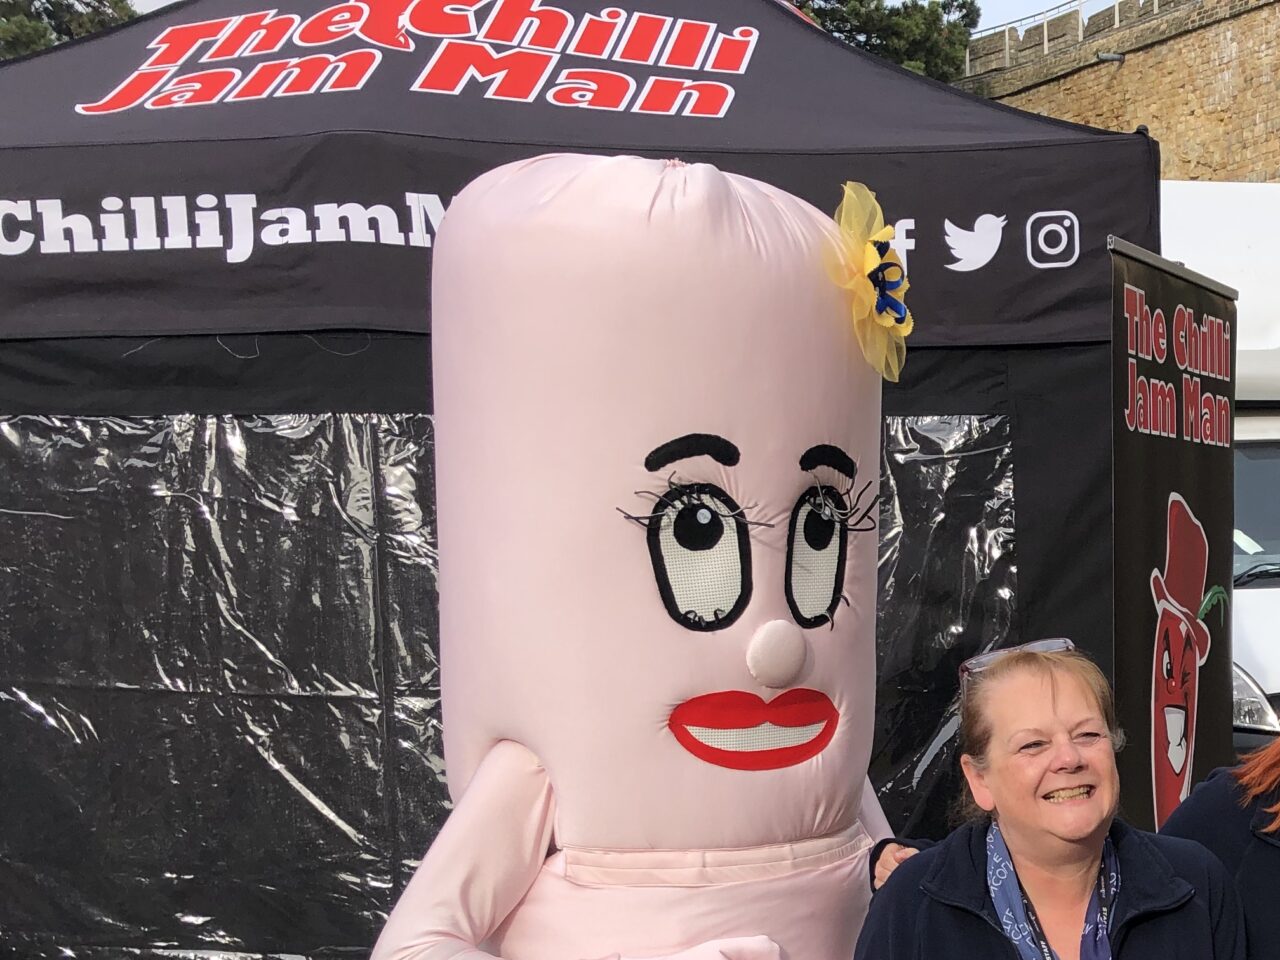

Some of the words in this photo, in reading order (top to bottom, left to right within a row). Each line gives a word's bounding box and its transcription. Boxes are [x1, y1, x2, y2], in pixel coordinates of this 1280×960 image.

[74, 48, 382, 115] Jam
[409, 38, 735, 118] Man
[138, 2, 369, 70] The
[405, 0, 759, 74] Chilli
[1123, 283, 1167, 364] The
[1172, 303, 1231, 382] Chilli
[1124, 358, 1177, 438] Jam
[1182, 373, 1231, 448] Man
